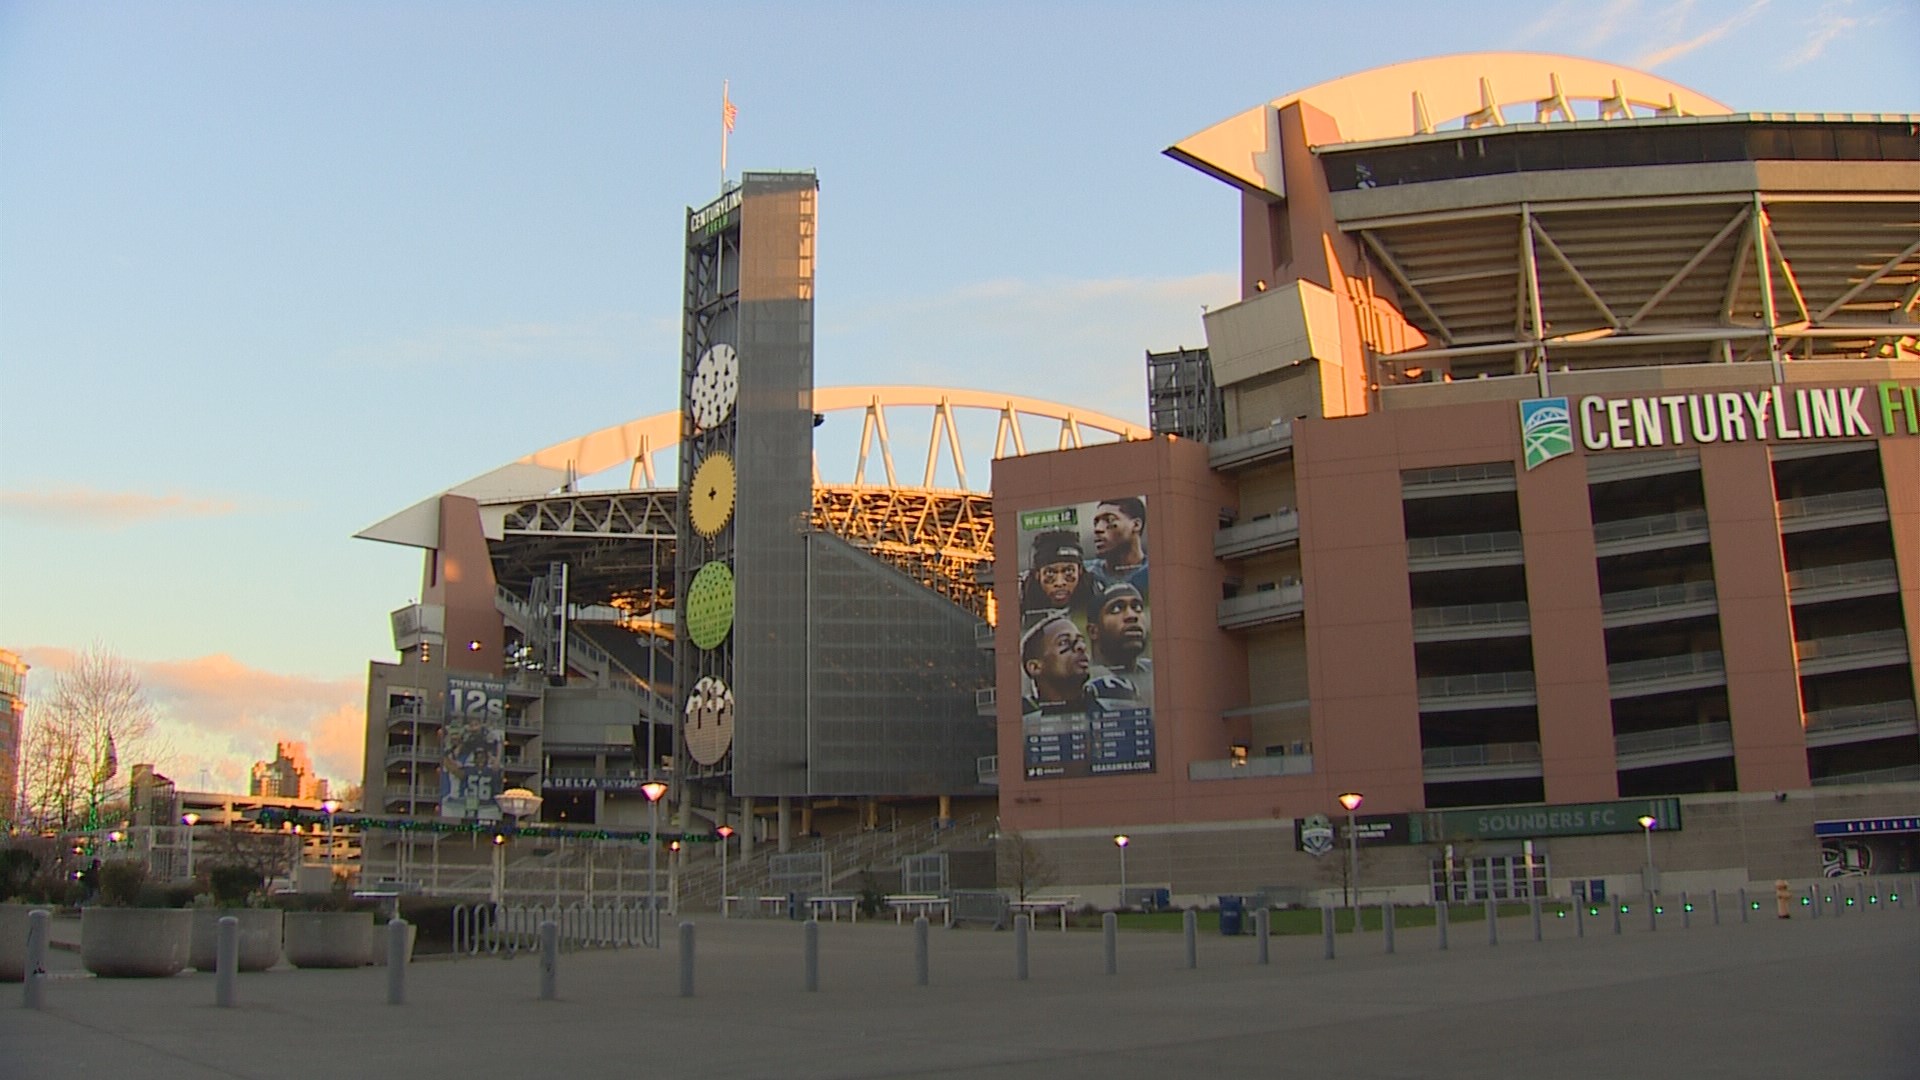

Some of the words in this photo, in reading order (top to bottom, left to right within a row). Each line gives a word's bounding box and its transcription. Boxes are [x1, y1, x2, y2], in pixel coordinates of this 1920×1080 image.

[1580, 385, 1872, 450] CENTURYLINK
[1879, 380, 1920, 436] FI
[1061, 510, 1072, 521] 12
[450, 679, 483, 690] THANK
[485, 681, 504, 691] YOU
[1092, 761, 1151, 772] SEAHAWKS.COM
[466, 774, 492, 800] 56
[555, 778, 597, 788] DELTA
[1478, 811, 1585, 833] SOUNDERS
[1590, 809, 1616, 826] FC
